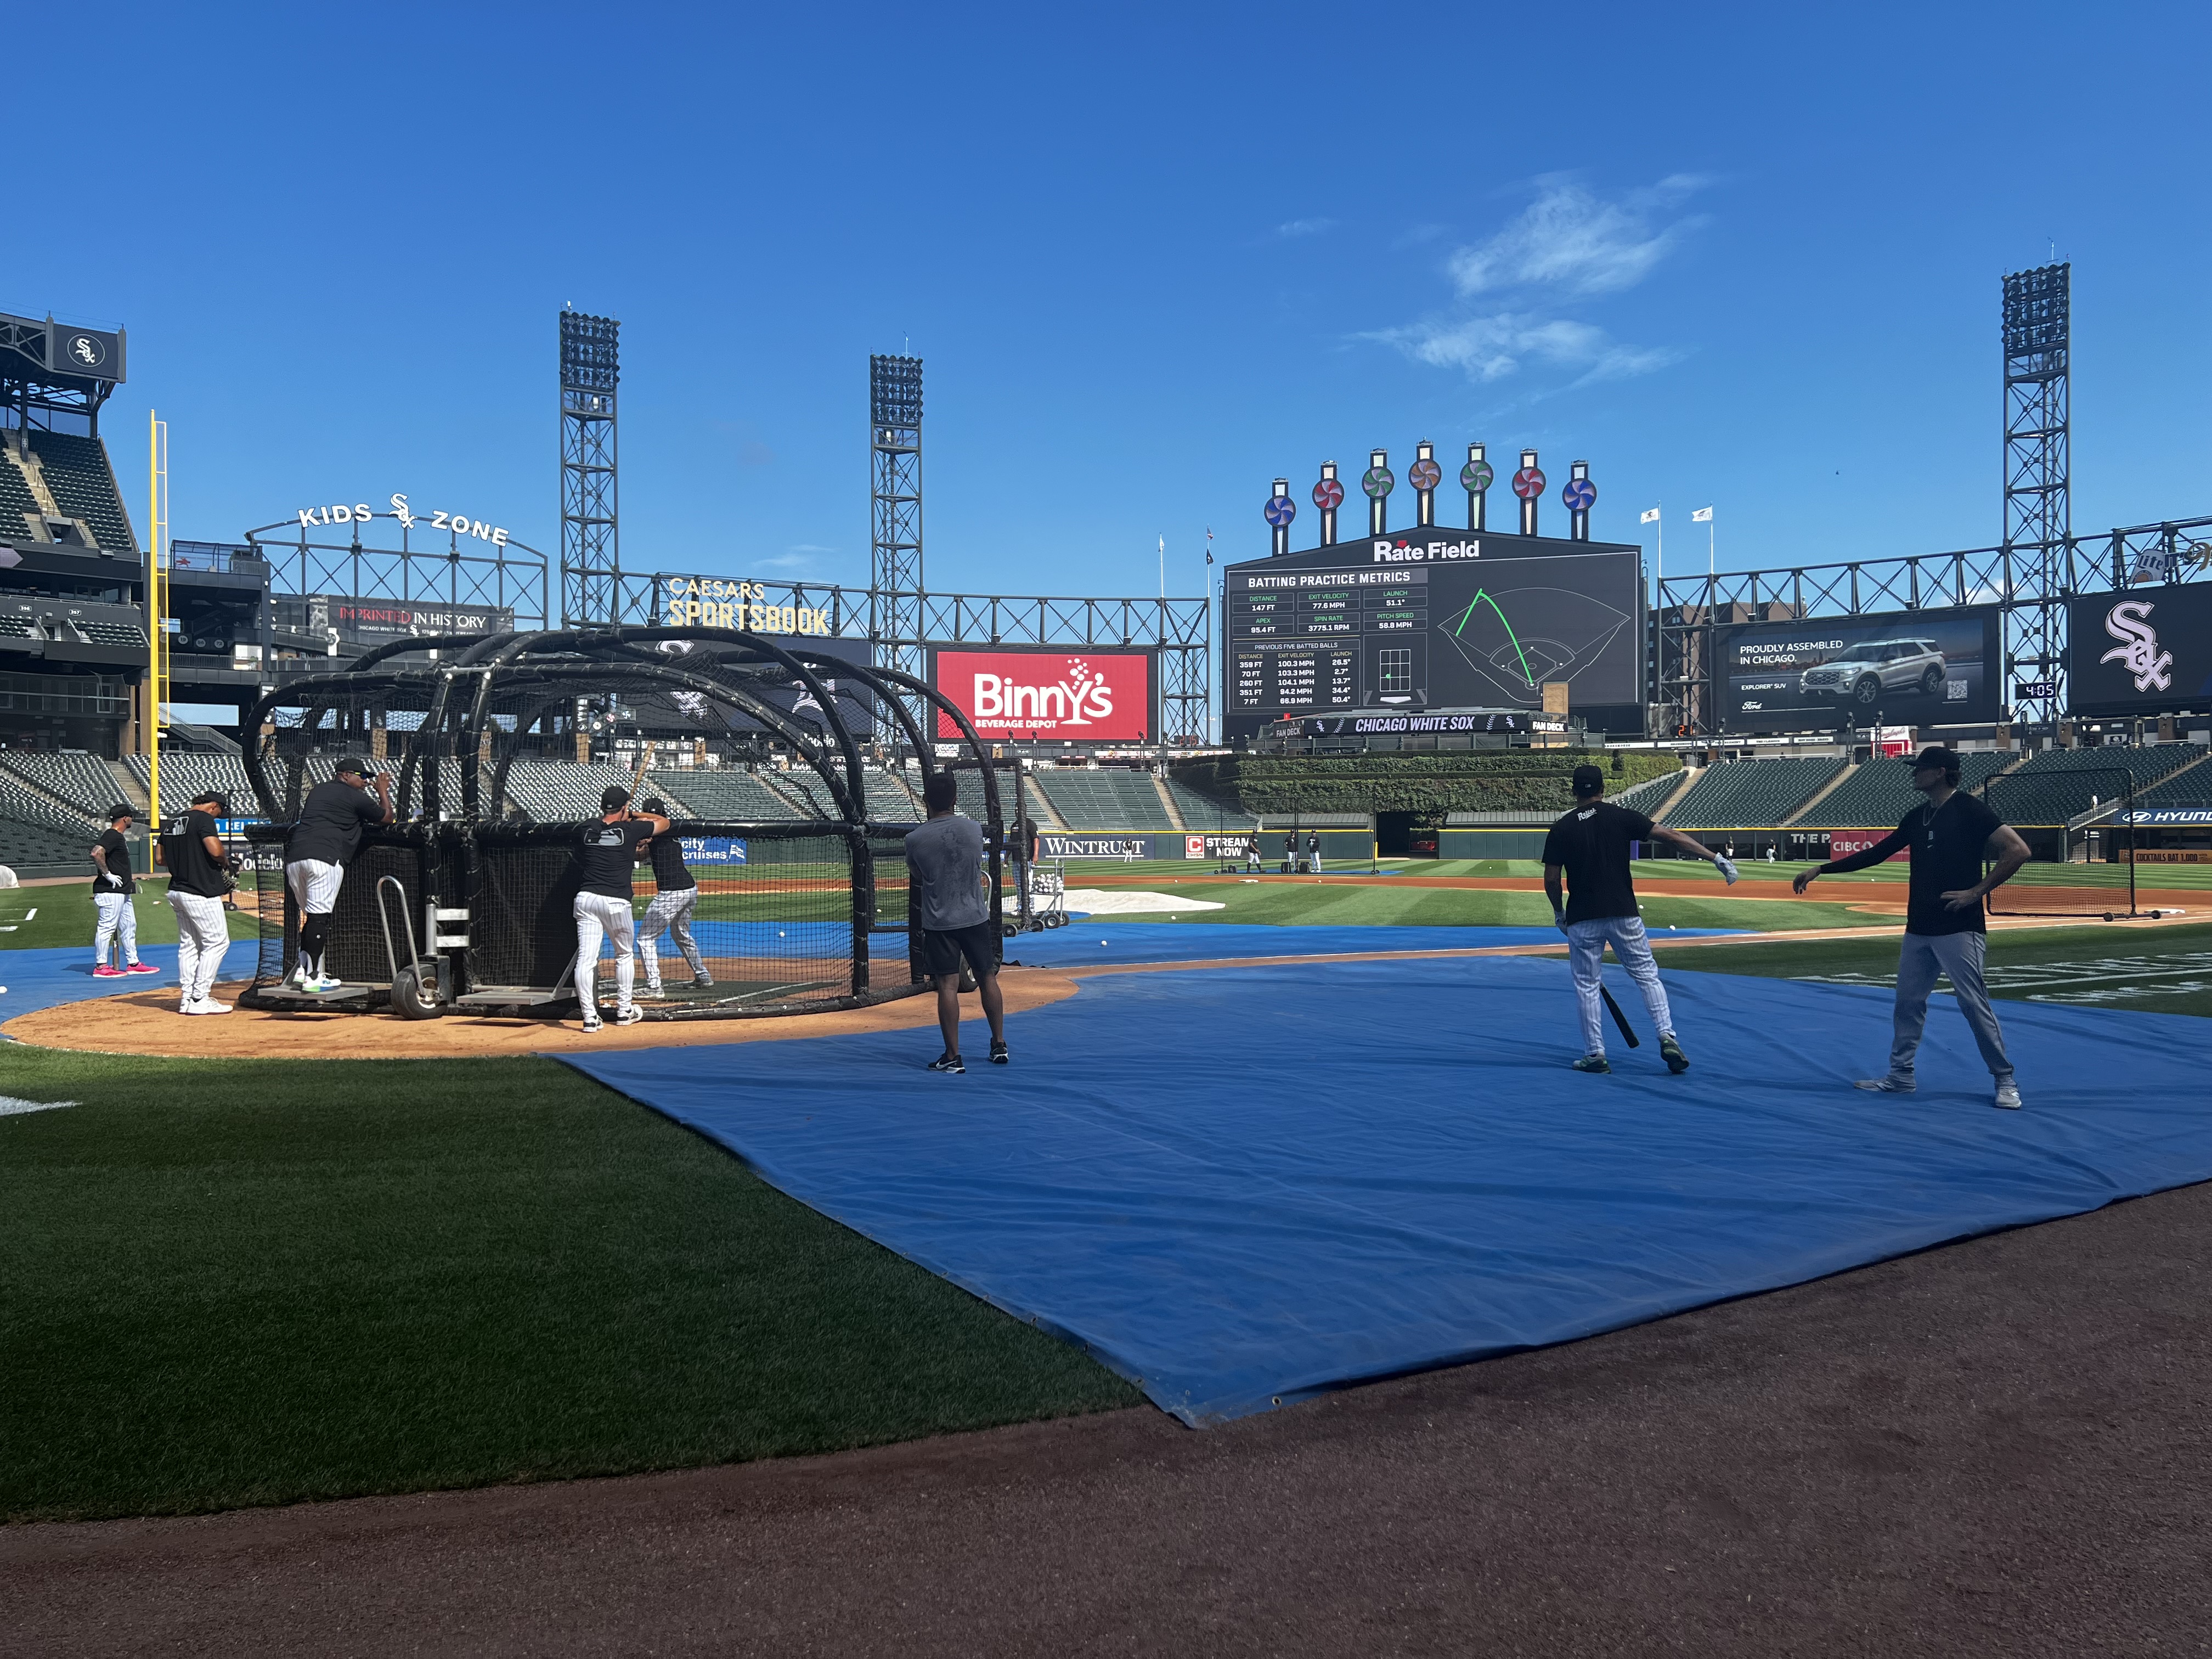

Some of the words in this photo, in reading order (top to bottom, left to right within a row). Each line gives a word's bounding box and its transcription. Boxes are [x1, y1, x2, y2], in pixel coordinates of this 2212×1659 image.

[298, 504, 373, 528] KIDS
[431, 510, 509, 547] ZONE
[1374, 540, 1425, 562] Rate
[1428, 540, 1480, 560] Field
[2137, 555, 2163, 569] Lite
[1248, 577, 1296, 588] BATTING
[1300, 574, 1356, 585] PRACTICE
[1359, 571, 1410, 583] METRICS
[669, 578, 765, 599] CAESARS
[340, 607, 411, 624] IMPRINTED
[414, 612, 427, 624] IN
[431, 614, 486, 629] HISORY
[669, 600, 830, 635] SPORTSBOOK
[1740, 644, 1784, 654] PROUDLY
[1786, 640, 1843, 651] ASSEMBLED
[1752, 654, 1797, 664] CHICAGO.
[2025, 685, 2054, 697] 4:05
[1741, 701, 1762, 710] Ford
[975, 719, 1024, 728] BEVERAGE
[1025, 720, 1057, 729] DEPOT
[1355, 718, 1409, 732] CHICAGO
[1410, 716, 1448, 731] WHITE
[1449, 716, 1475, 730] SOX
[1532, 721, 1546, 731] FAN
[1547, 723, 1565, 732] DECK
[1276, 729, 1286, 738] FAN
[1286, 727, 1301, 736] DECK
[1206, 837, 1249, 847] STREAM
[1791, 833, 1818, 843] THE
[681, 838, 704, 851] city
[1833, 841, 1860, 852] CIBC
[681, 849, 727, 860] cruises
[1216, 847, 1242, 856] NOW
[2136, 853, 2166, 862] COCKTAILS
[2168, 853, 2179, 862] BAT
[2180, 853, 2198, 862] 1.000
